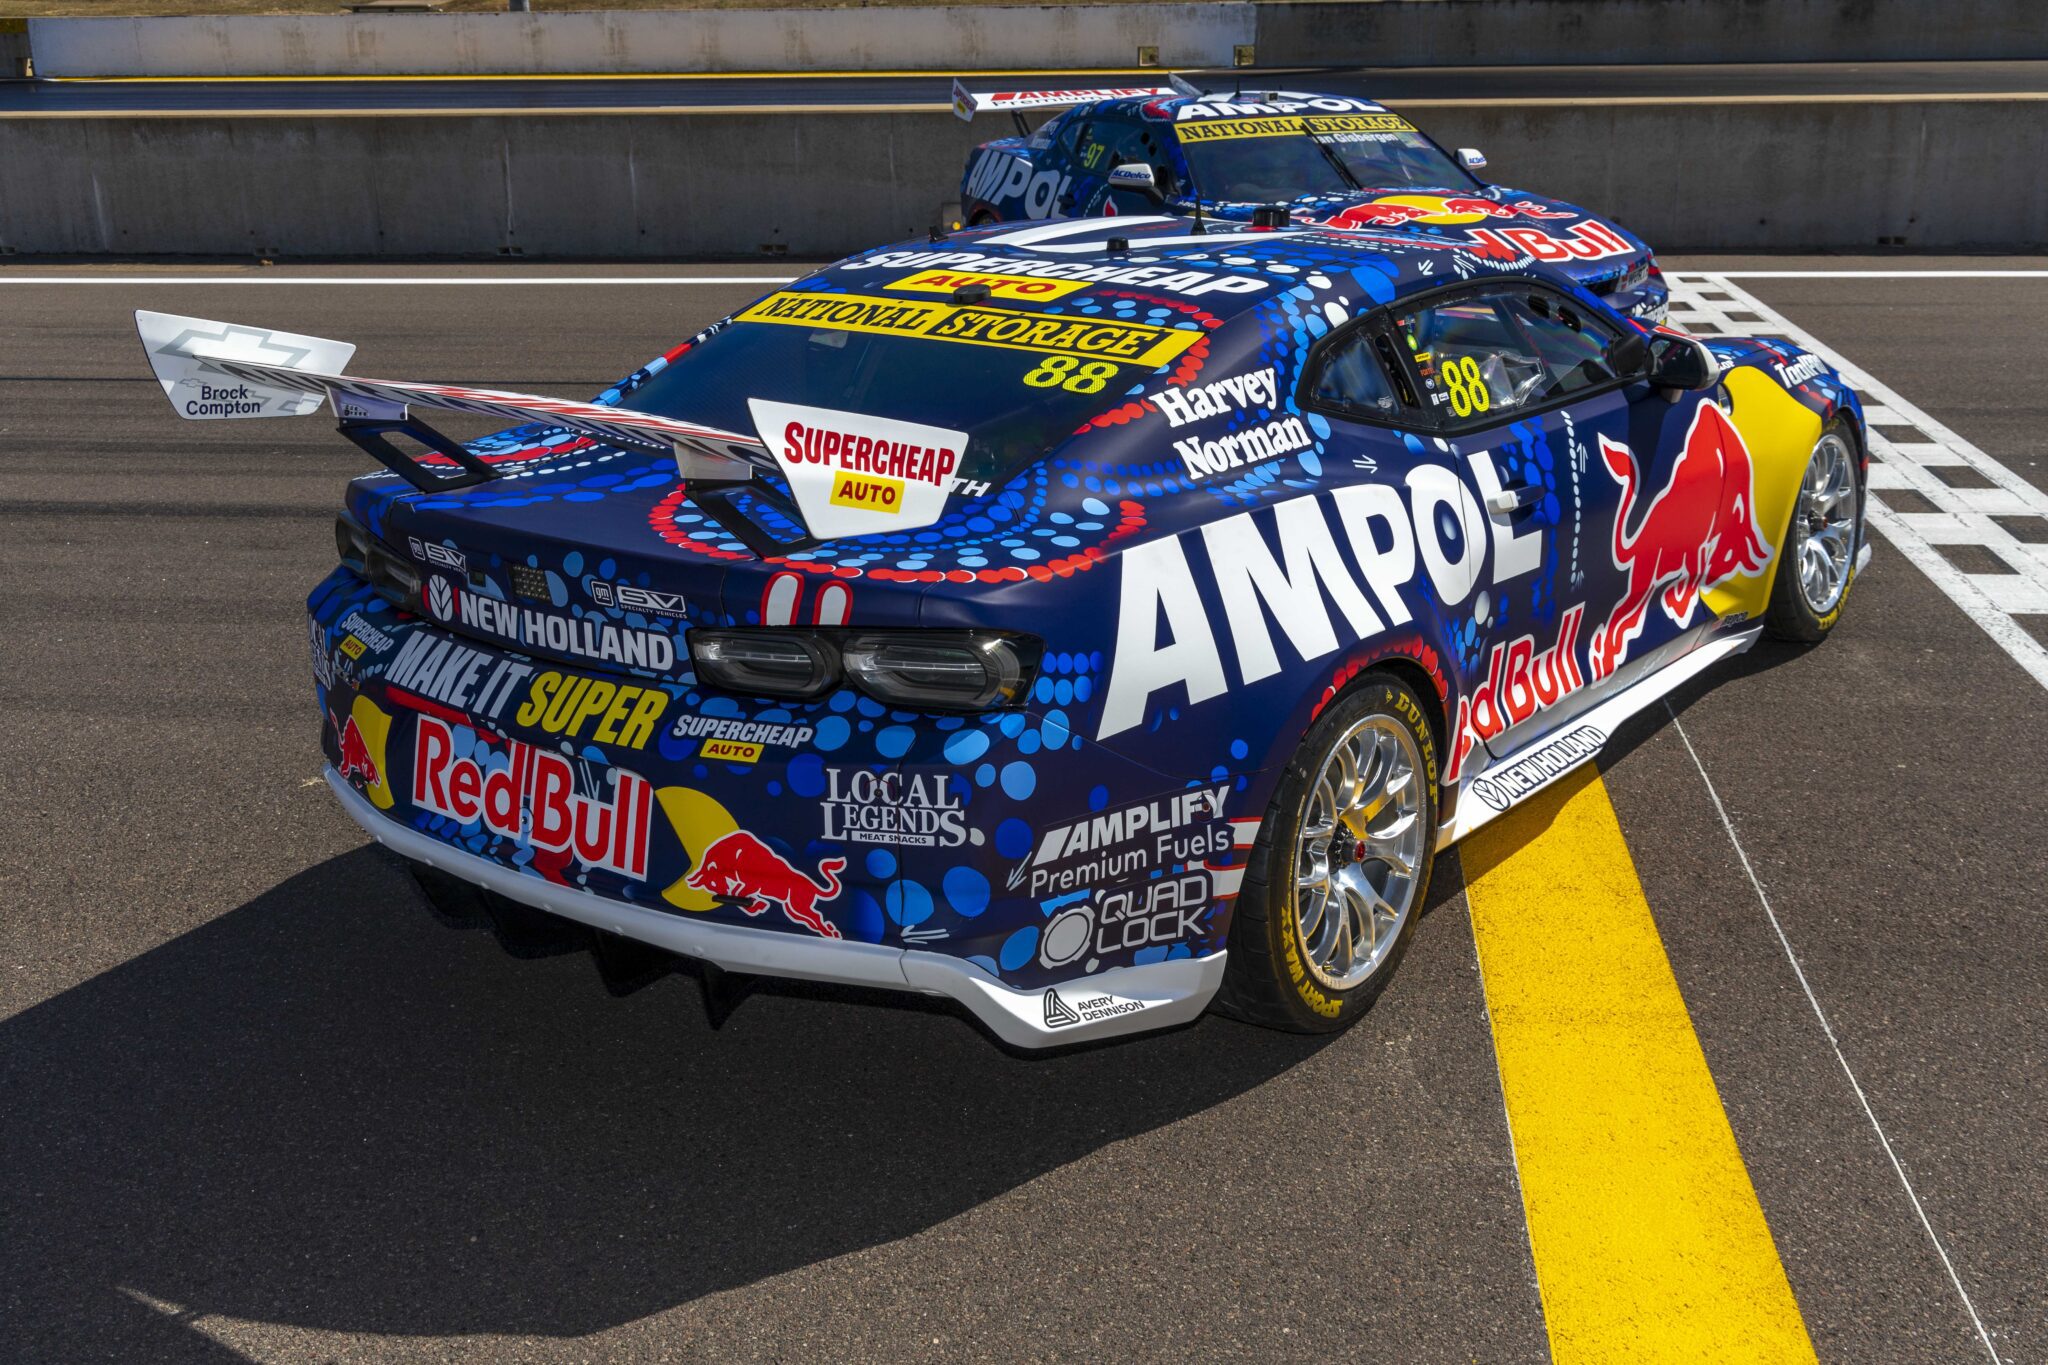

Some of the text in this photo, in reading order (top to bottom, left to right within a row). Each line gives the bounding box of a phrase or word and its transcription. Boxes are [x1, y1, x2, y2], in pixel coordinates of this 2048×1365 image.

[1019, 88, 1159, 99] AMPLIFY
[1177, 98, 1386, 120] AMPOL
[1177, 116, 1409, 140] NATIONAL STORAGE
[1084, 144, 1106, 169] 97
[1111, 169, 1151, 180] ACDelco
[966, 148, 1073, 219] AMPOL
[840, 251, 1269, 296] SUPERCHEAP
[914, 273, 1058, 294] AUTO
[754, 296, 1153, 356] NATIONAL STORAGE
[201, 384, 249, 402] Brock
[1022, 355, 1120, 395] 88
[1441, 355, 1490, 418] 88
[185, 398, 261, 417] Compton
[1148, 367, 1277, 428] Harvey
[783, 420, 955, 489] SUPERCHEAP
[1172, 416, 1312, 480] Norman
[838, 480, 897, 506] AUTO
[619, 604, 688, 619] SPECIALTY VEHICLES
[1096, 450, 1544, 743] AMPOL
[340, 612, 395, 656] SUPERCHEAP
[343, 639, 364, 656] AUTO
[459, 591, 675, 671] NEW HOLLAND
[384, 629, 485, 709] MAKE
[471, 658, 538, 720] IT
[514, 670, 670, 751] SUPER
[672, 714, 815, 750] SUPERCHEAP
[706, 742, 756, 759] AUTO
[1395, 692, 1438, 805] DUNLOP
[1492, 725, 1608, 799] NEW HOLLAND
[826, 768, 959, 810] LOCAL
[820, 802, 968, 848] LEGENDS
[859, 831, 928, 846] MEAT SNACKS
[1061, 785, 1231, 859] AMPLIFY
[1030, 824, 1230, 899] Premium Fuels
[1100, 874, 1209, 925] QUAD
[1095, 906, 1206, 954] LOCK
[1077, 995, 1114, 1012] AVERY
[1083, 1000, 1146, 1022] DENNISON
